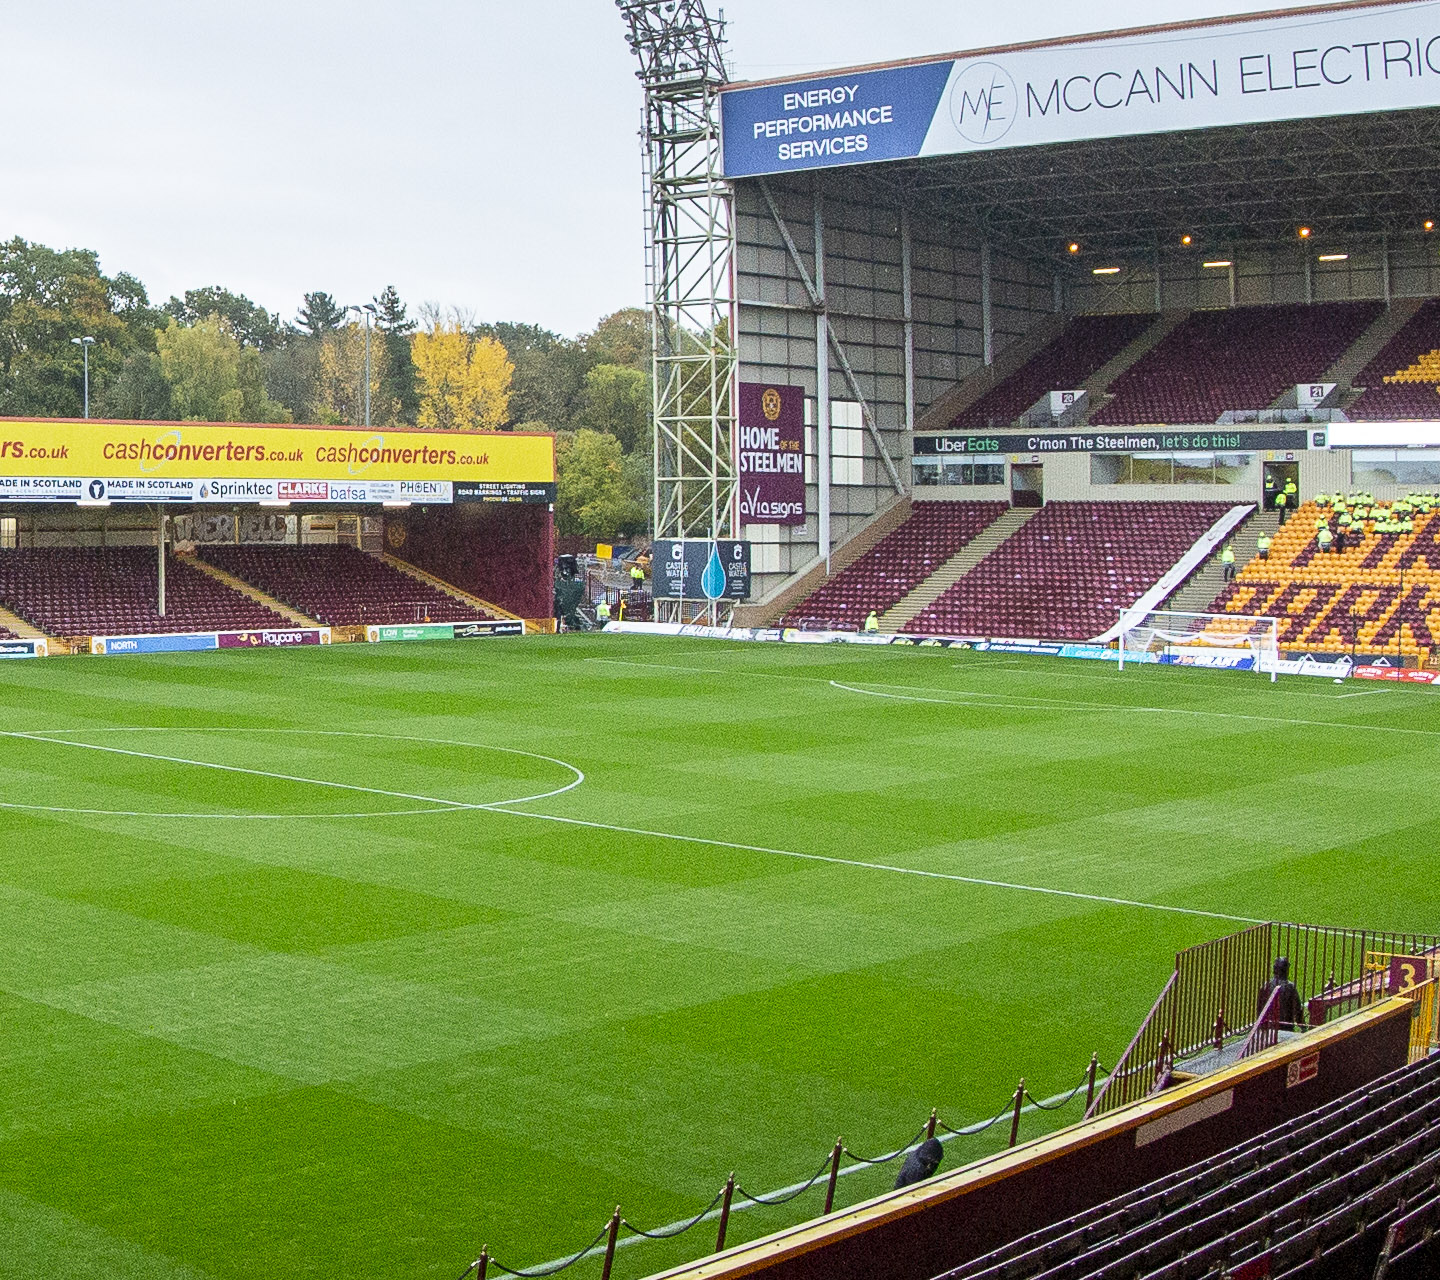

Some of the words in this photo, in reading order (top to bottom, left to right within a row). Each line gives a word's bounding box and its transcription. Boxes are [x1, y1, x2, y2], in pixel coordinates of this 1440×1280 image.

[783, 84, 859, 112] ENERGY
[1026, 58, 1219, 119] MCCANN
[752, 106, 894, 140] PERFORMANCE
[778, 134, 869, 161] SERVICES
[740, 426, 780, 450] HOME
[935, 438, 967, 452] Uber
[967, 437, 999, 452] Eats
[1027, 436, 1068, 451] C'mon
[1070, 436, 1094, 450] The
[1096, 435, 1160, 451] Steelmen,
[1161, 435, 1190, 450] let's
[1192, 434, 1210, 449] do
[1212, 434, 1241, 448] this!
[102, 438, 304, 462] cashconverters.co.uk
[316, 442, 490, 466] cashconverters.co.uk
[740, 452, 803, 474] STEELMEN
[20, 479, 30, 488] IN
[32, 479, 83, 489] SCOTLAND
[107, 480, 134, 489] MADE
[135, 480, 145, 489] IN
[147, 480, 194, 490] SCOTLAND
[210, 481, 274, 498] Sprinktec
[278, 482, 328, 494] CLARKE
[330, 486, 367, 500] bafsa
[110, 640, 138, 650] NORTH
[262, 631, 303, 646] Paycare
[1398, 963, 1416, 991] 3
